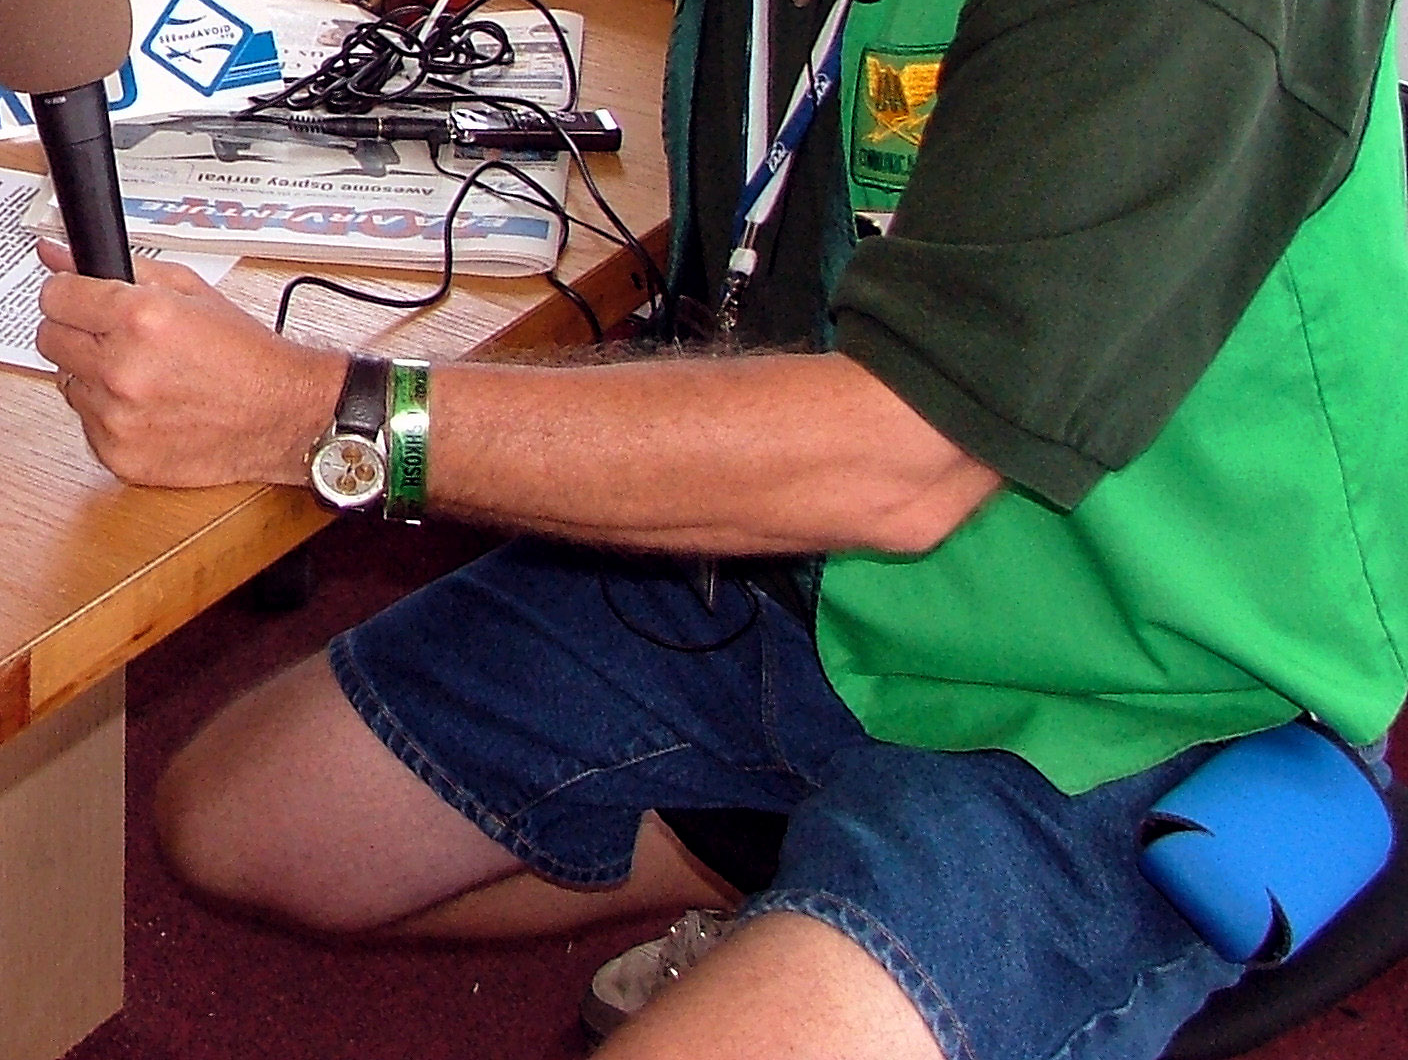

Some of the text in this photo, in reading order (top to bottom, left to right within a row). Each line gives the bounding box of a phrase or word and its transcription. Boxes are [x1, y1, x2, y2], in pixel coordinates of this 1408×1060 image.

[197, 172, 261, 186] arrival
[267, 177, 333, 191] Osprey
[341, 183, 435, 197] Awesome
[413, 214, 508, 229] EAA
[400, 410, 425, 489] SHKOSH
